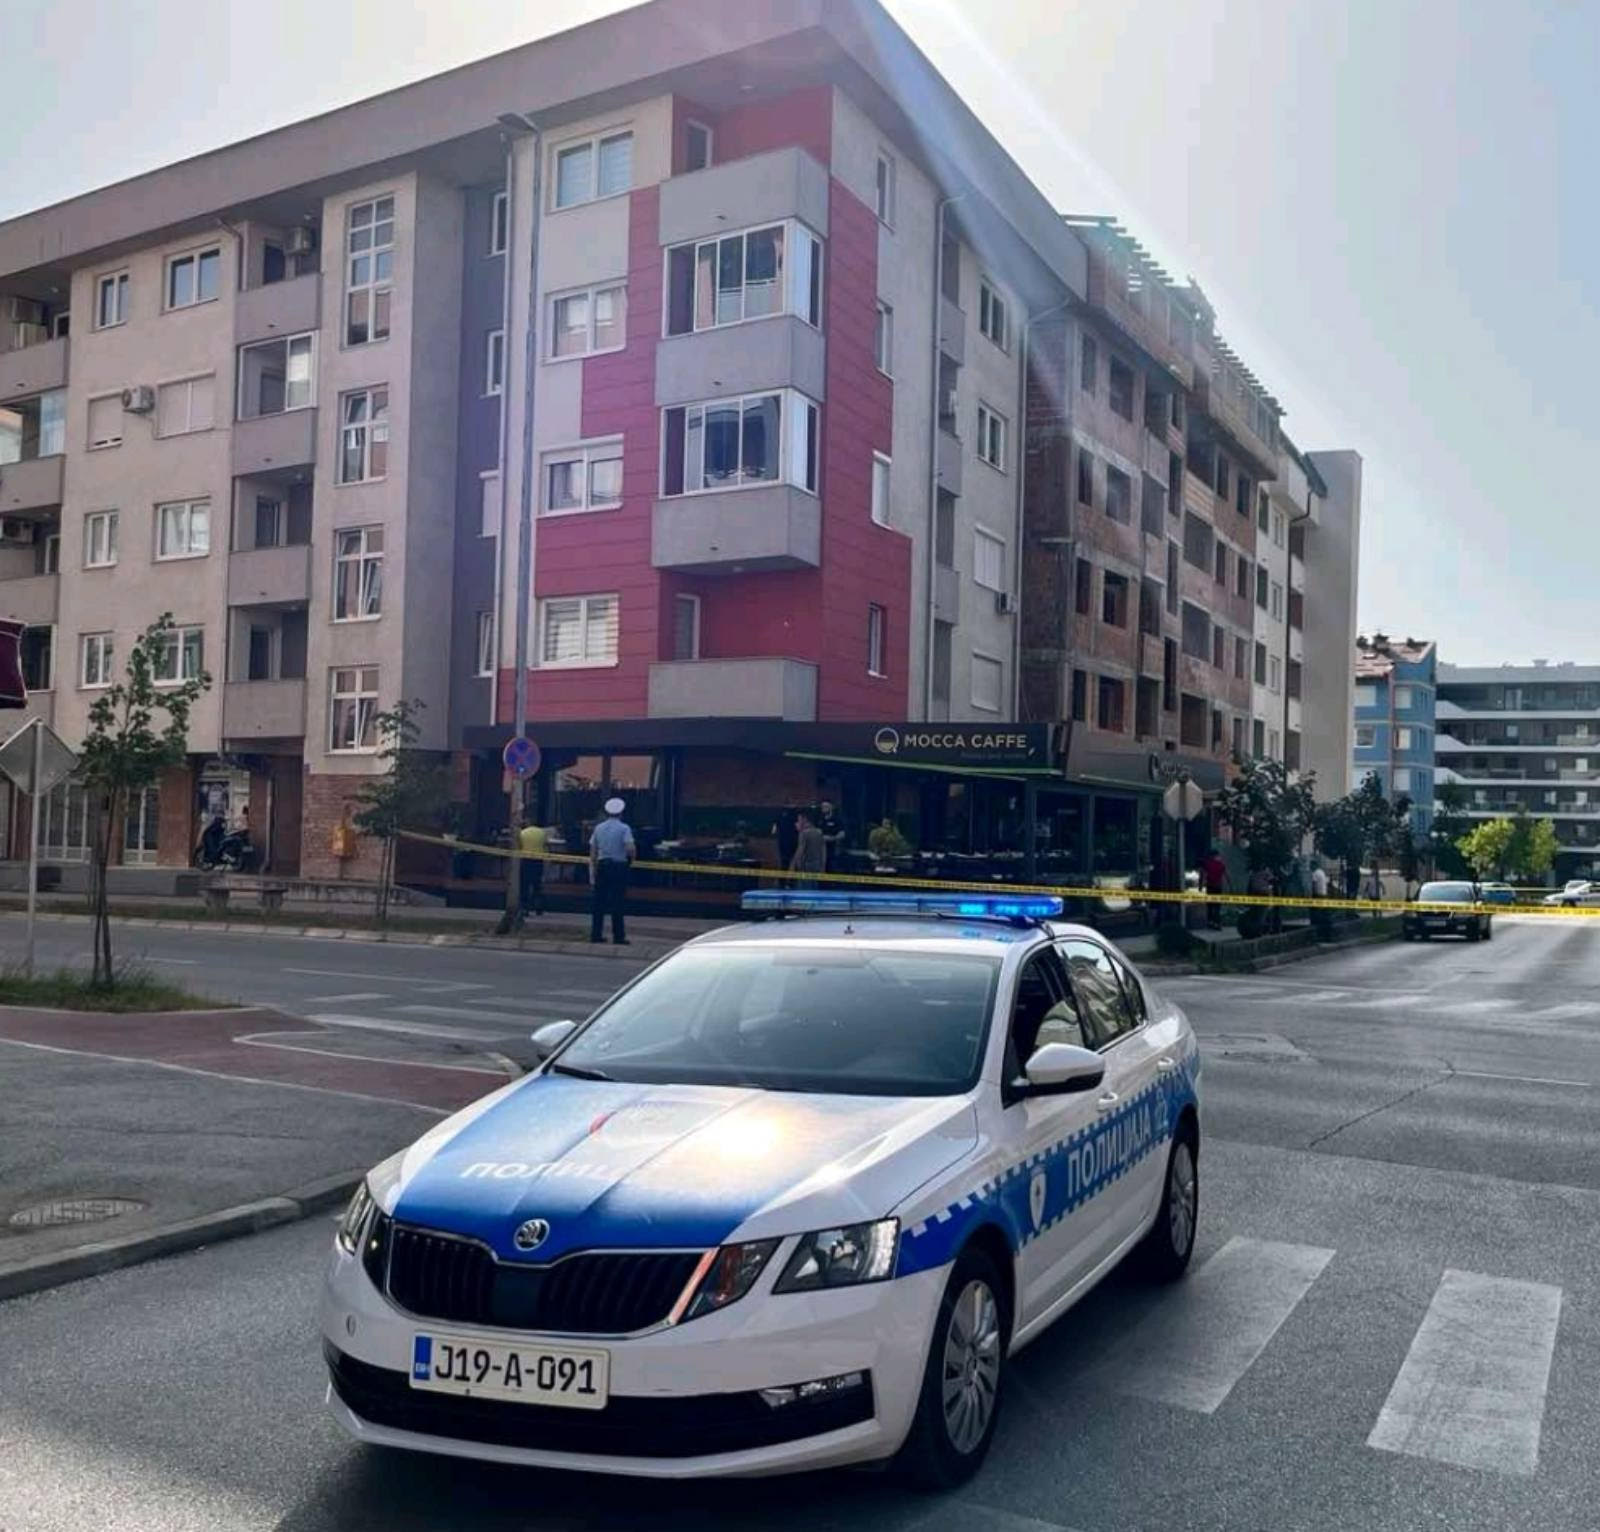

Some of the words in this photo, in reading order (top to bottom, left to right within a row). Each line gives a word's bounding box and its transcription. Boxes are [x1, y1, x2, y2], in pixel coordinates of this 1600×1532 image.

[904, 734, 966, 748] MOCCA
[970, 734, 1027, 748] CAFFE
[435, 1345, 597, 1395] J19-A-091
